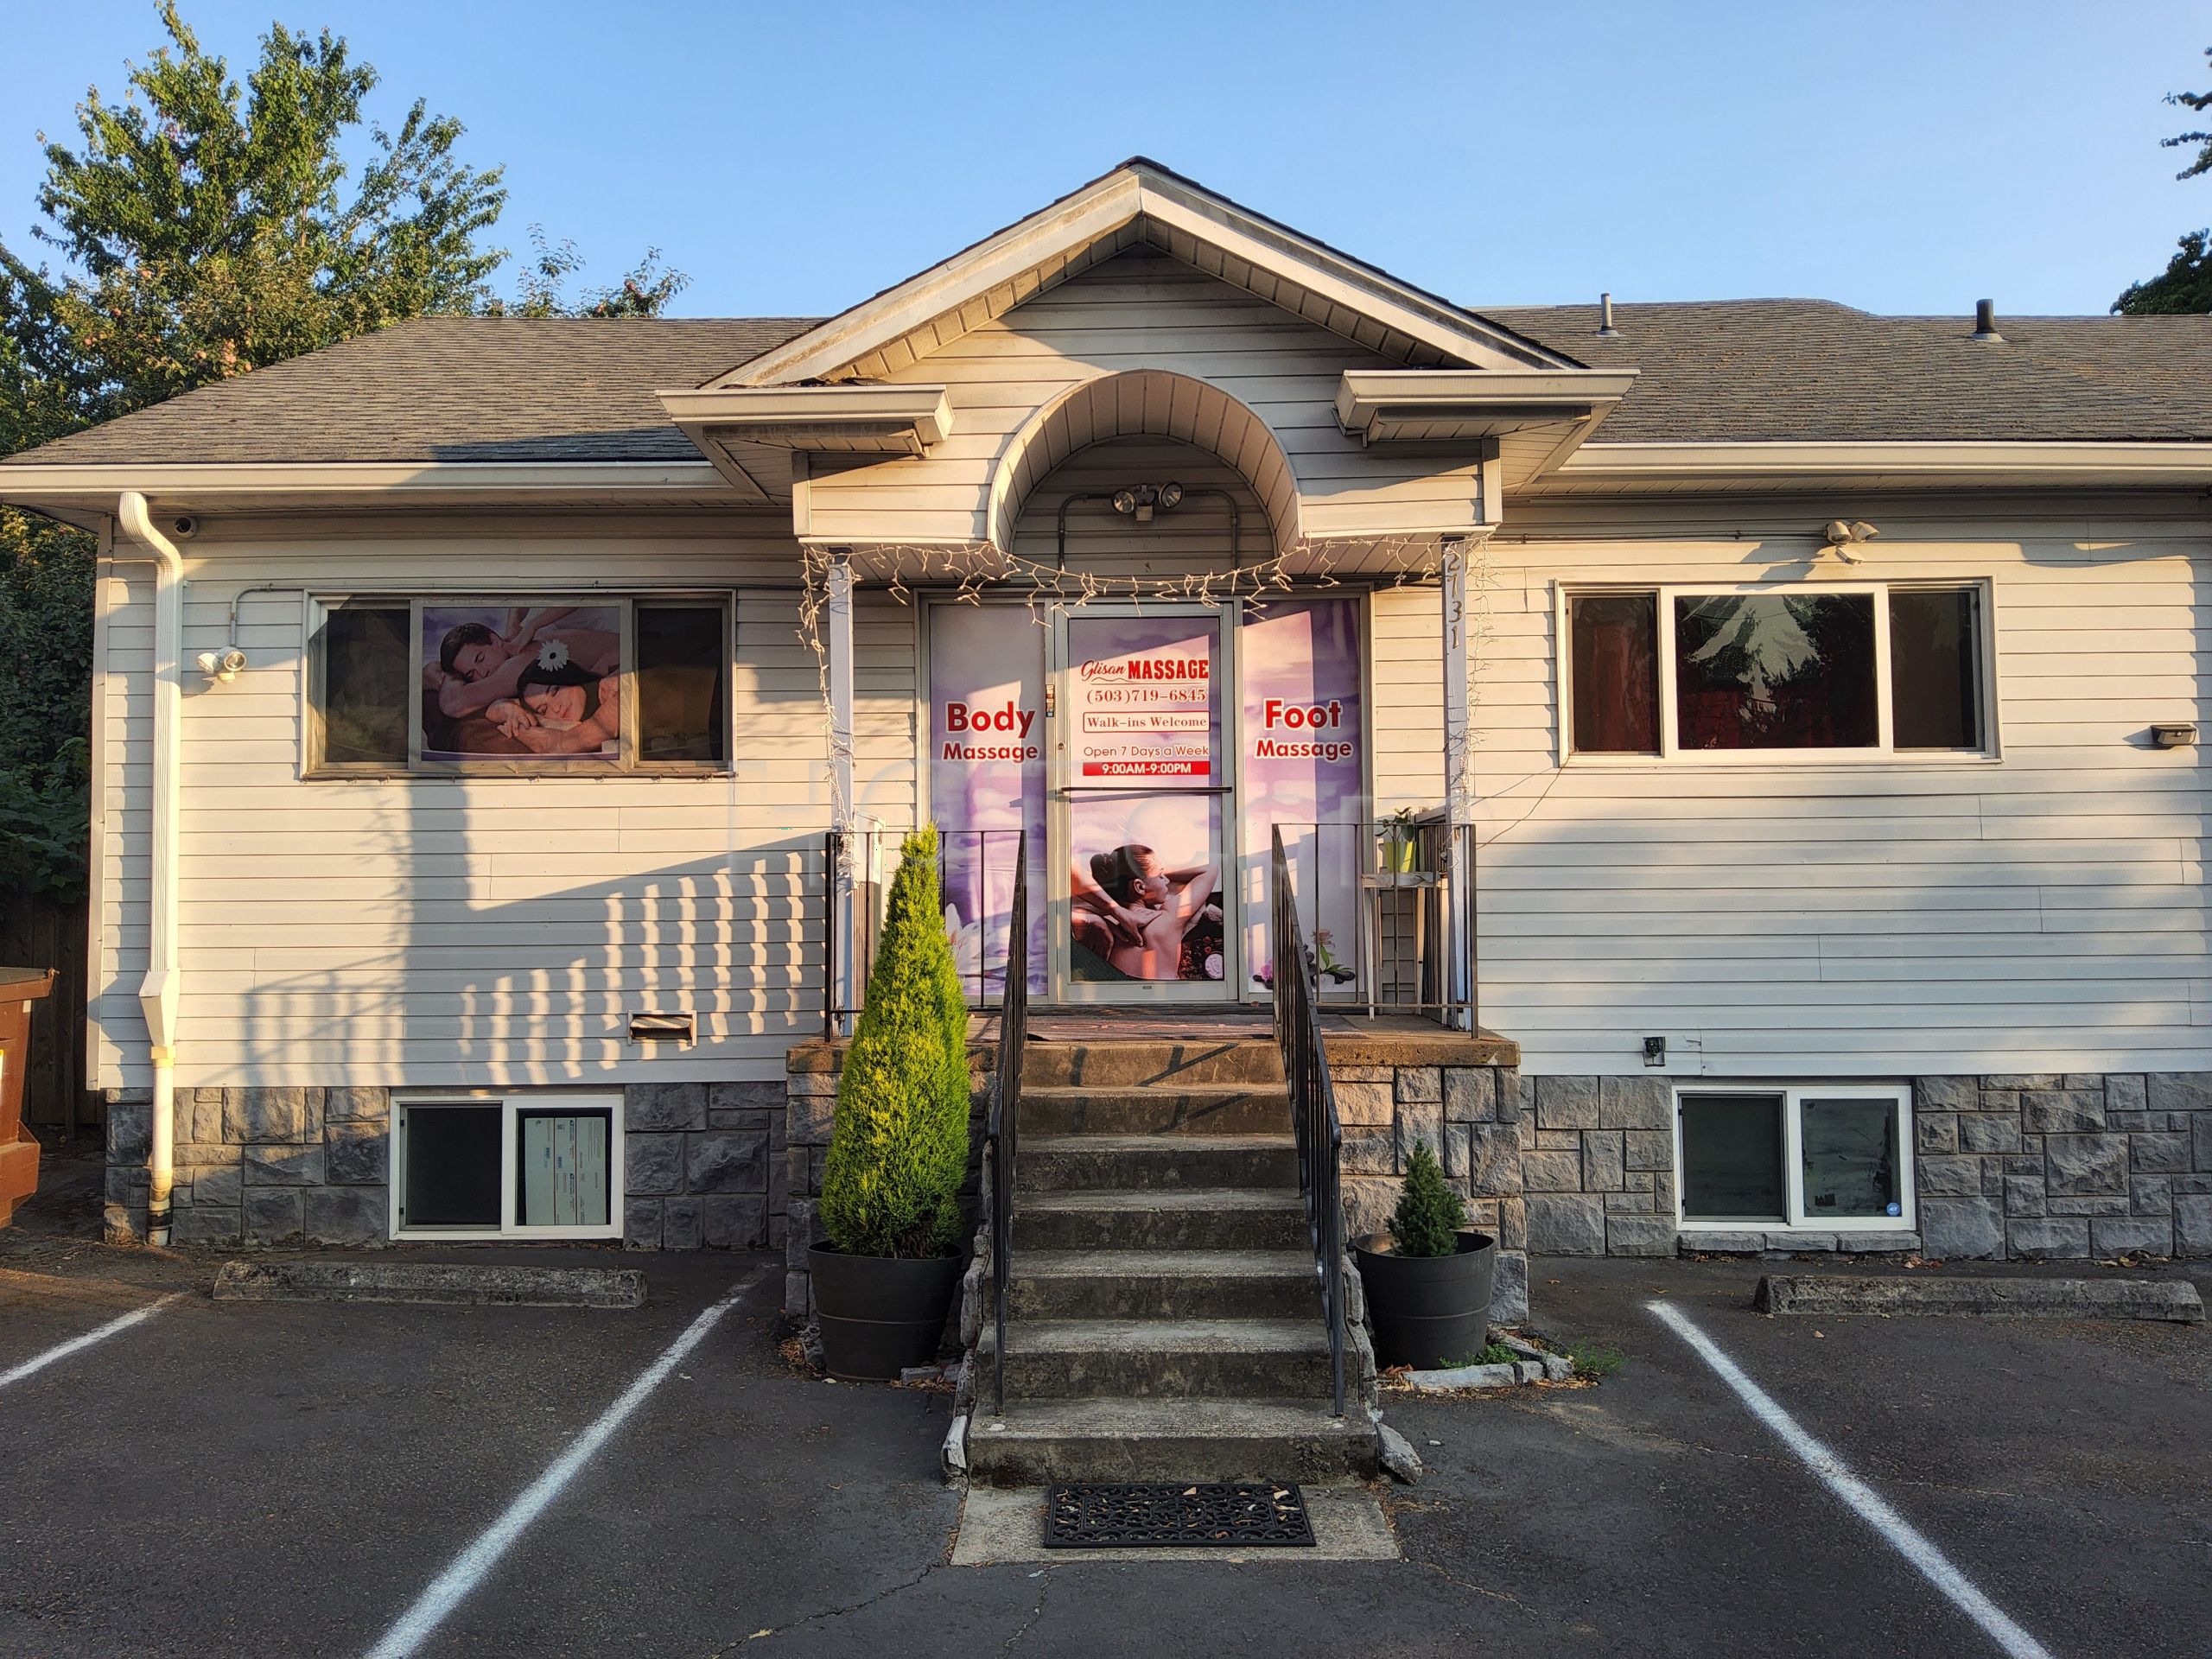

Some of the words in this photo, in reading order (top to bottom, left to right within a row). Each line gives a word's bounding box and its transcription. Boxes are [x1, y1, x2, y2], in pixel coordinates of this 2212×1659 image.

[1081, 660, 1126, 681] Glisan
[1128, 659, 1209, 679] MASSAGE
[1086, 689, 1207, 704] (503)719-6845
[947, 701, 1036, 739] Body
[1087, 716, 1146, 728] Walk-ins
[1150, 716, 1207, 728] Welcome
[1265, 700, 1341, 728] Foot
[943, 742, 1039, 764] Massage
[1084, 747, 1116, 759] Open
[1121, 747, 1127, 756] 7
[1131, 746, 1160, 758] Days
[1163, 747, 1172, 756] a
[1175, 746, 1210, 756] Week
[1256, 740, 1352, 761] Massage
[1102, 763, 1192, 775] 9:00AM-9:00PM
